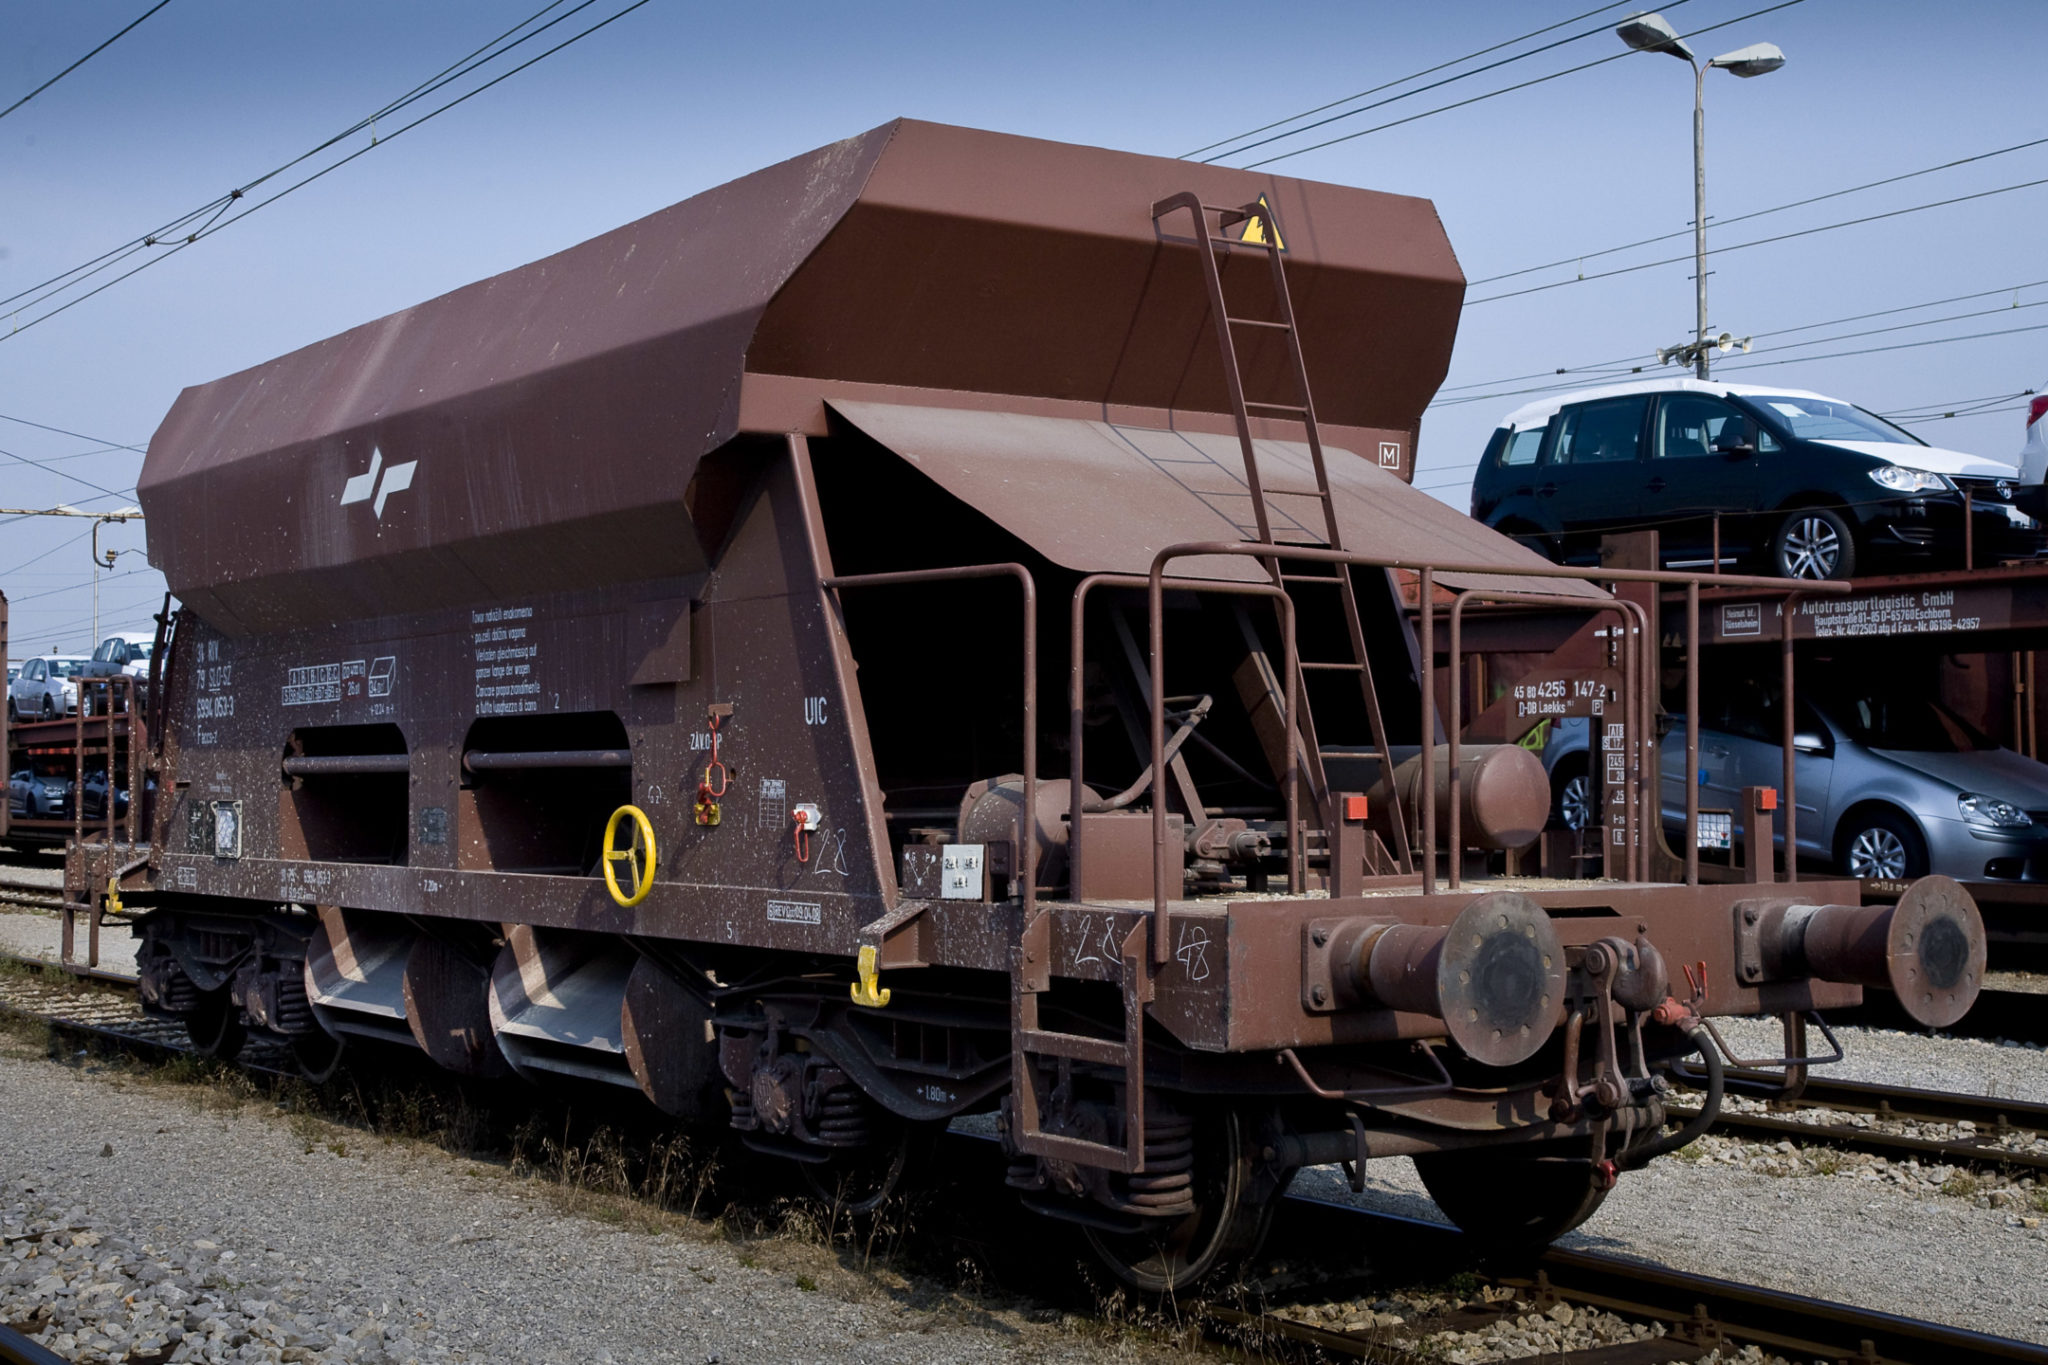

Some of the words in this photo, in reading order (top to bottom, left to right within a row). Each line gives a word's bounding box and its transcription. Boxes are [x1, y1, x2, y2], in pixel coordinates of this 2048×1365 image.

[1383, 447, 1395, 464] M
[1801, 593, 1915, 616] Autotransportlogistic
[1922, 590, 1954, 607] GmbH
[1814, 612, 1857, 627] Hauptstraße
[1858, 611, 1880, 624] 81-85
[1881, 609, 1915, 623] D-65760
[1915, 607, 1951, 620] Eschborn
[1514, 686, 1524, 699] 45
[1527, 686, 1536, 699] 80
[1538, 680, 1566, 698] 4256
[1574, 681, 1606, 698] 147-2
[554, 693, 560, 710] 2
[805, 697, 828, 725] UIC
[1519, 701, 1537, 717] D-DB
[1538, 701, 1566, 714] Laekks
[727, 922, 733, 939] 5
[1075, 914, 1122, 965] 28
